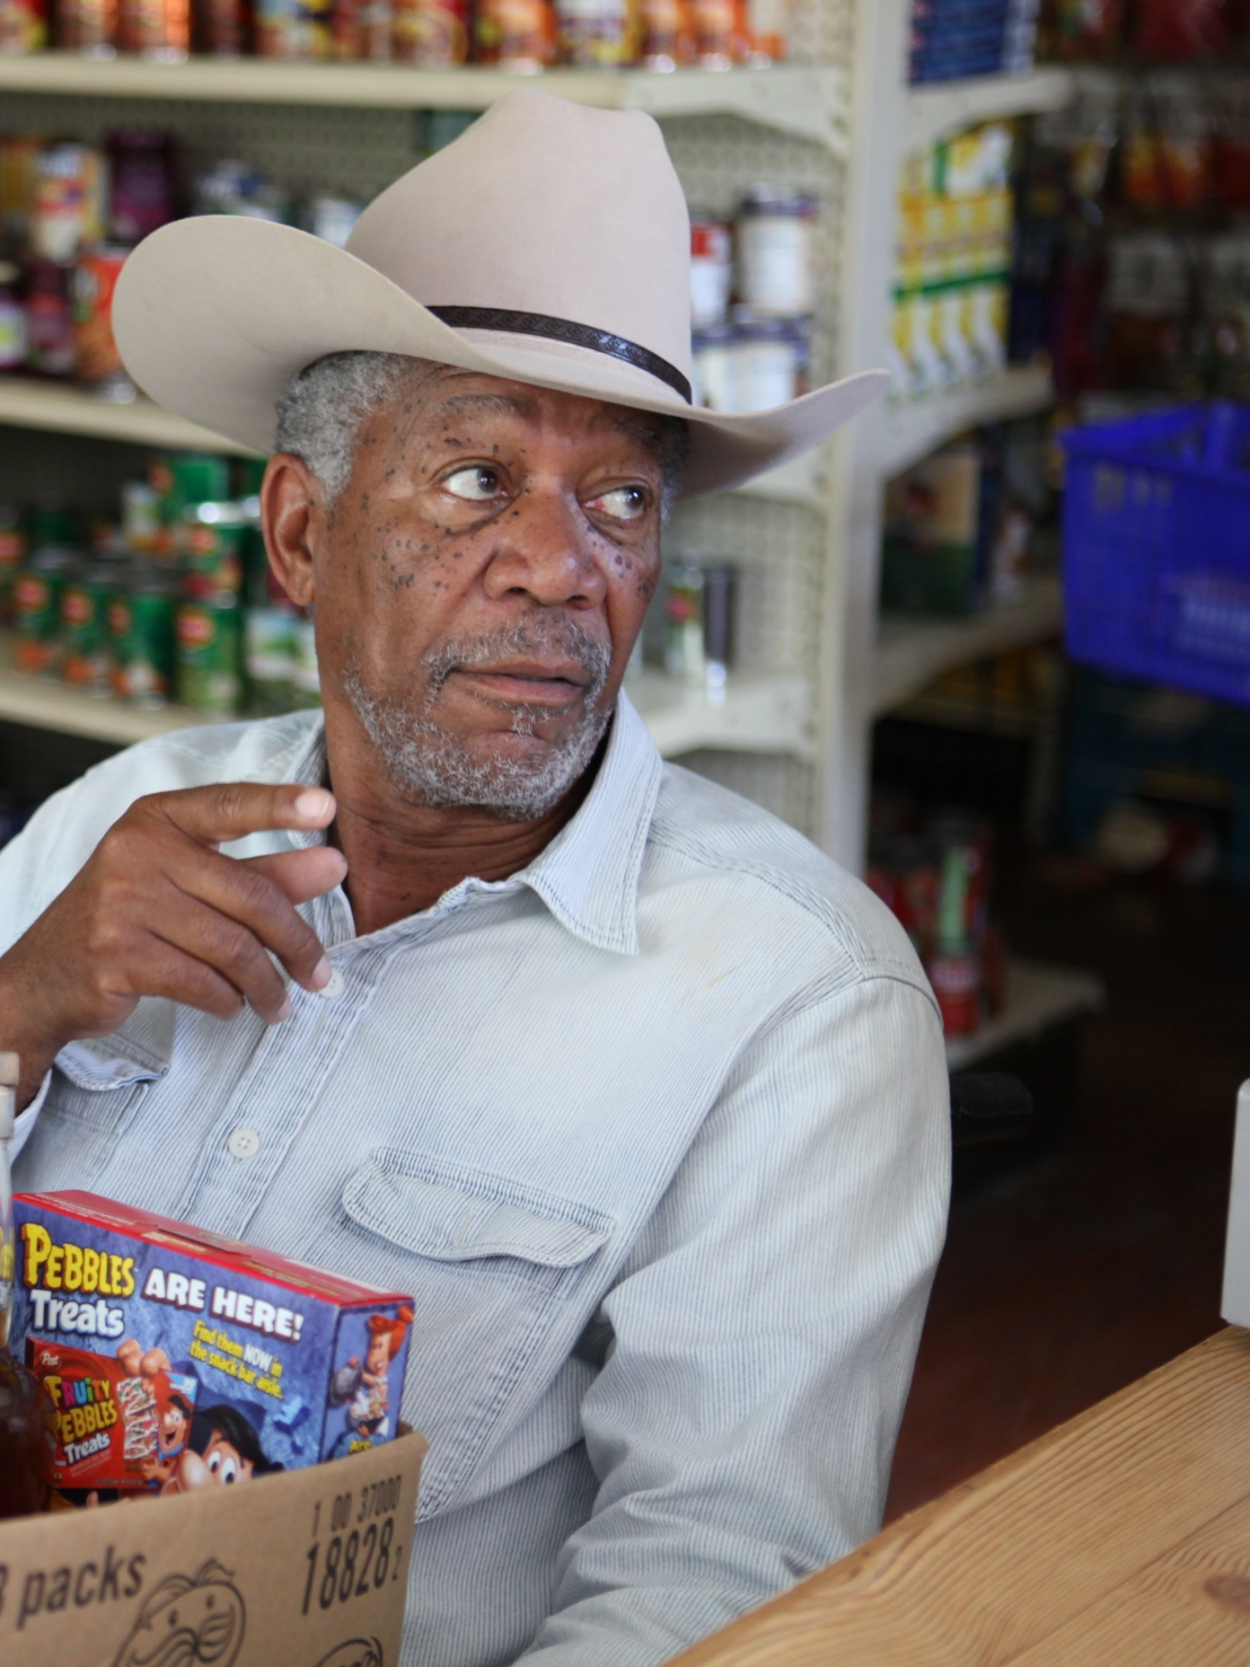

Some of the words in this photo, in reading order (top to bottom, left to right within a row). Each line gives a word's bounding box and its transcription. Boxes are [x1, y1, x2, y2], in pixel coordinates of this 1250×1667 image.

[21, 1222, 135, 1297] PEBBLES
[29, 1289, 125, 1338] Treats
[144, 1267, 207, 1309] ARE
[211, 1285, 305, 1342] HERE!
[41, 1351, 60, 1366] Post
[190, 1340, 208, 1361] the
[193, 1319, 218, 1345] Find
[216, 1332, 244, 1359] them
[243, 1343, 273, 1373] NOW
[271, 1357, 283, 1379] in
[64, 1432, 111, 1466] Treats
[312, 1501, 322, 1538] 1
[357, 1474, 402, 1524] 37000
[16, 1544, 147, 1631] packs
[301, 1517, 394, 1616] 18828
